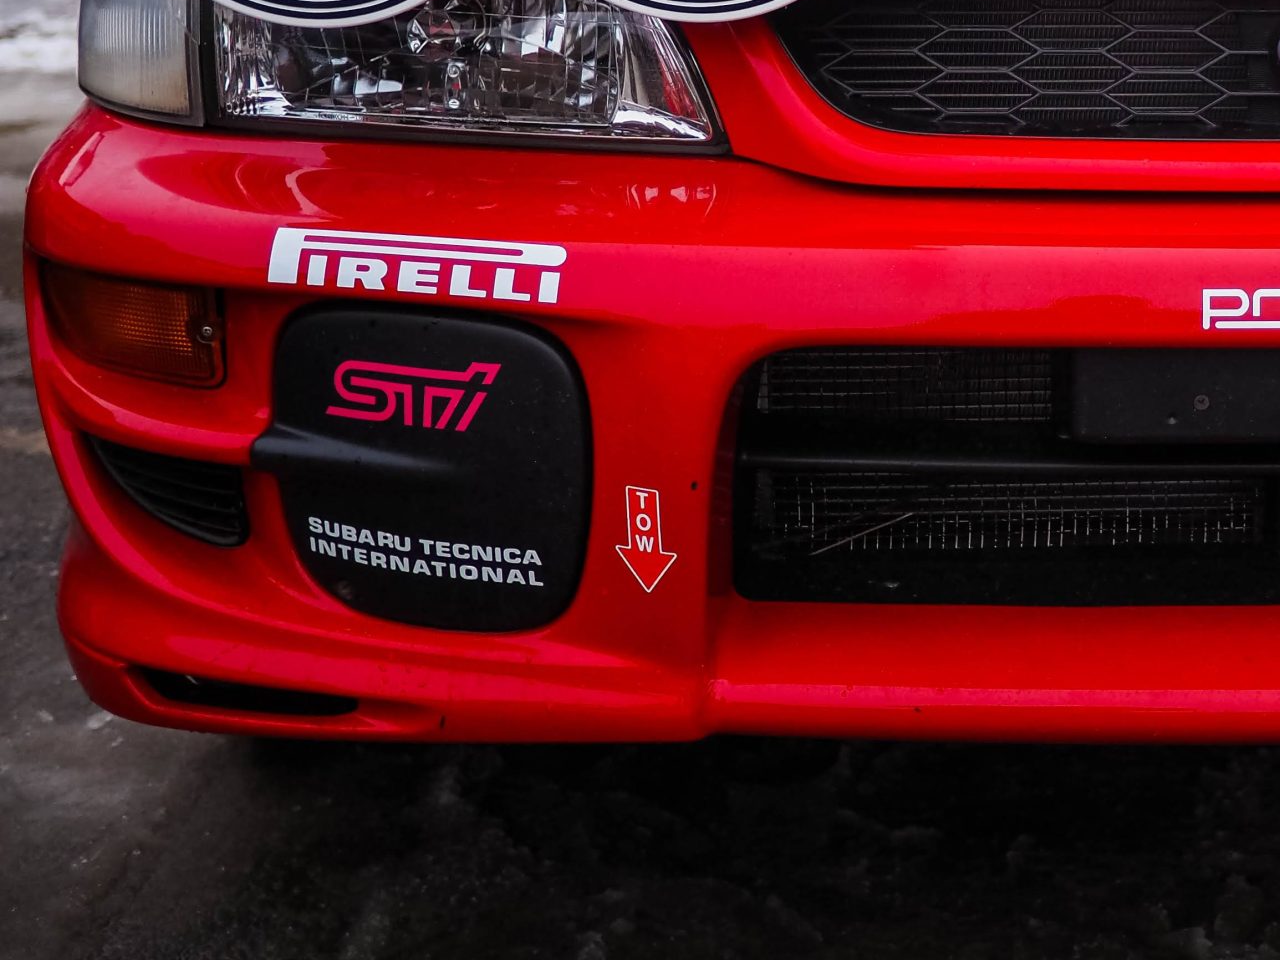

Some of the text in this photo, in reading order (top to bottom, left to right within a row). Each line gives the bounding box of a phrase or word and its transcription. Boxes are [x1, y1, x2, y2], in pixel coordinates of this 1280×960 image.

[267, 227, 568, 304] PIRELLI
[308, 516, 543, 567] SUBARU TECNICA
[634, 491, 655, 554] TOW
[310, 536, 544, 588] INTERNATIONAL
